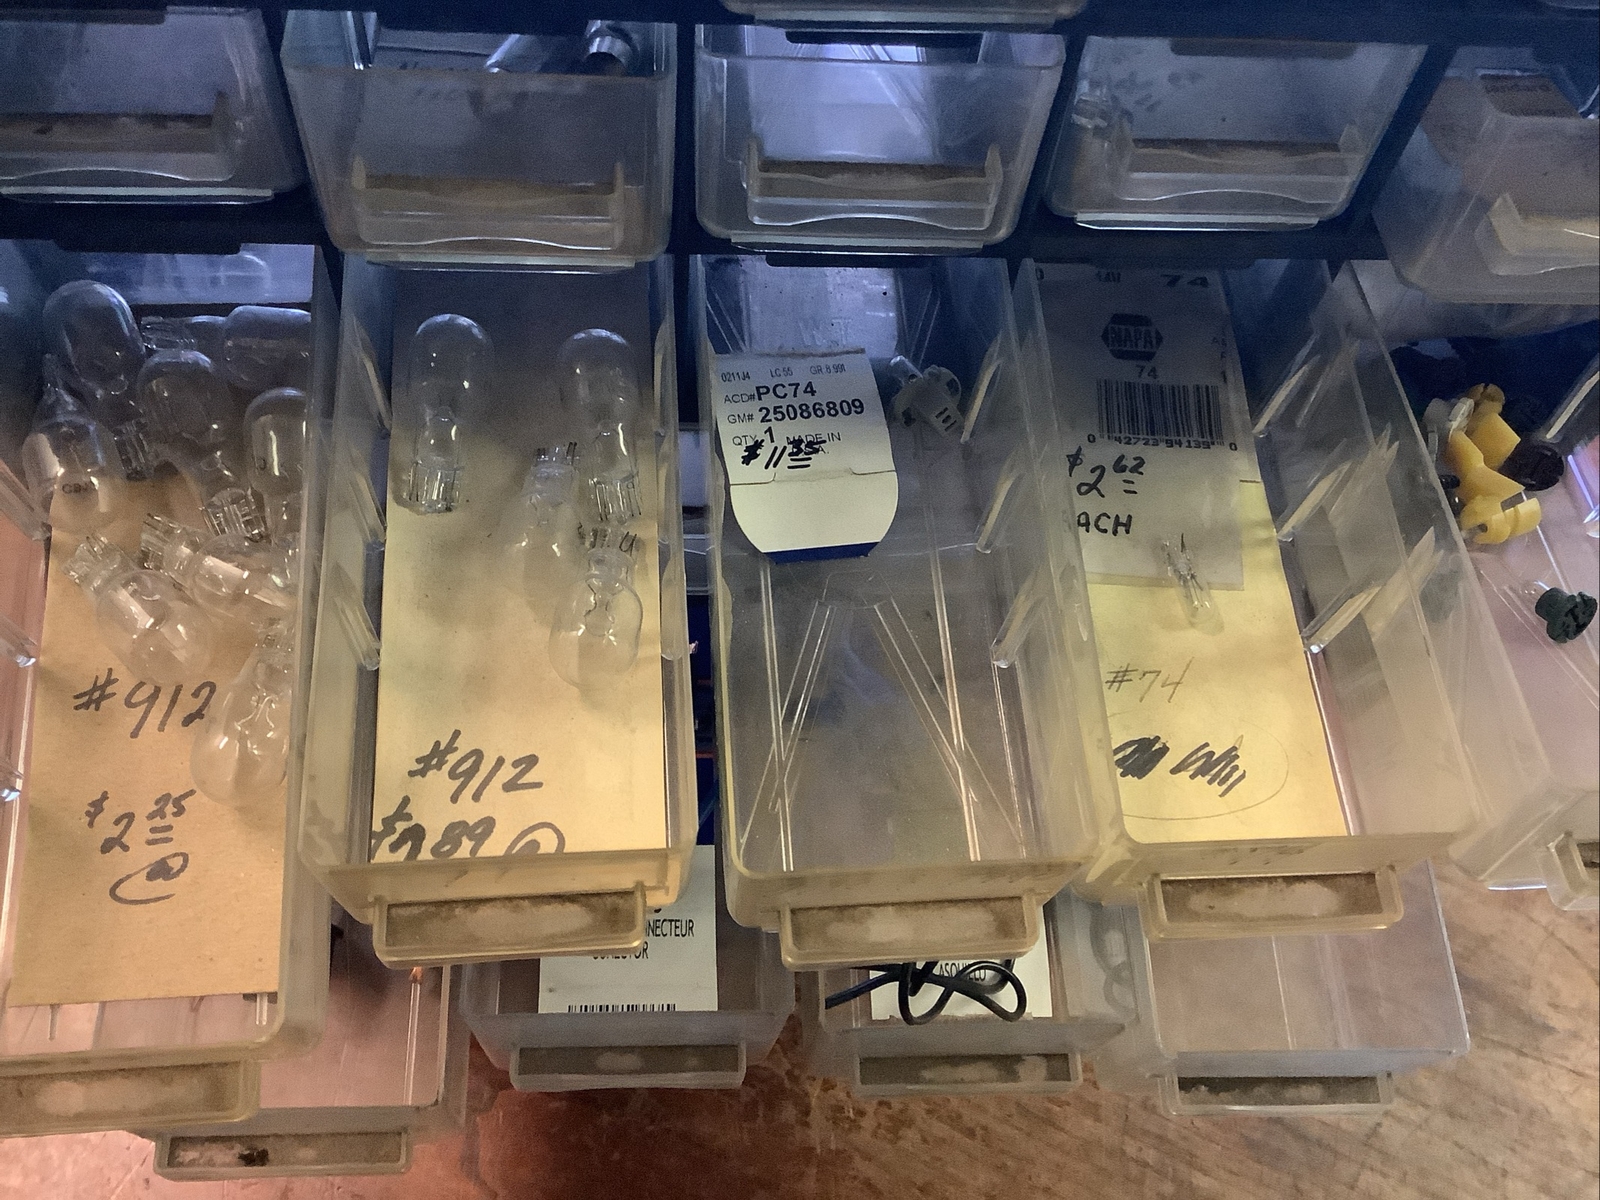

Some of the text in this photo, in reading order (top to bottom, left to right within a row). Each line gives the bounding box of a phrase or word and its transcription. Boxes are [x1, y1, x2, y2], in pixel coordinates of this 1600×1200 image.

[1109, 325, 1155, 350] NAPA
[782, 367, 794, 376] 55
[1135, 364, 1158, 380] 74
[755, 381, 817, 401] PC74
[727, 398, 865, 424] GM# 25086809
[763, 426, 775, 444] 1
[828, 432, 842, 442] IN
[1077, 511, 1132, 537] ACH
[1105, 656, 1195, 704] #74
[73, 667, 217, 739] #912
[407, 728, 543, 804] #912
